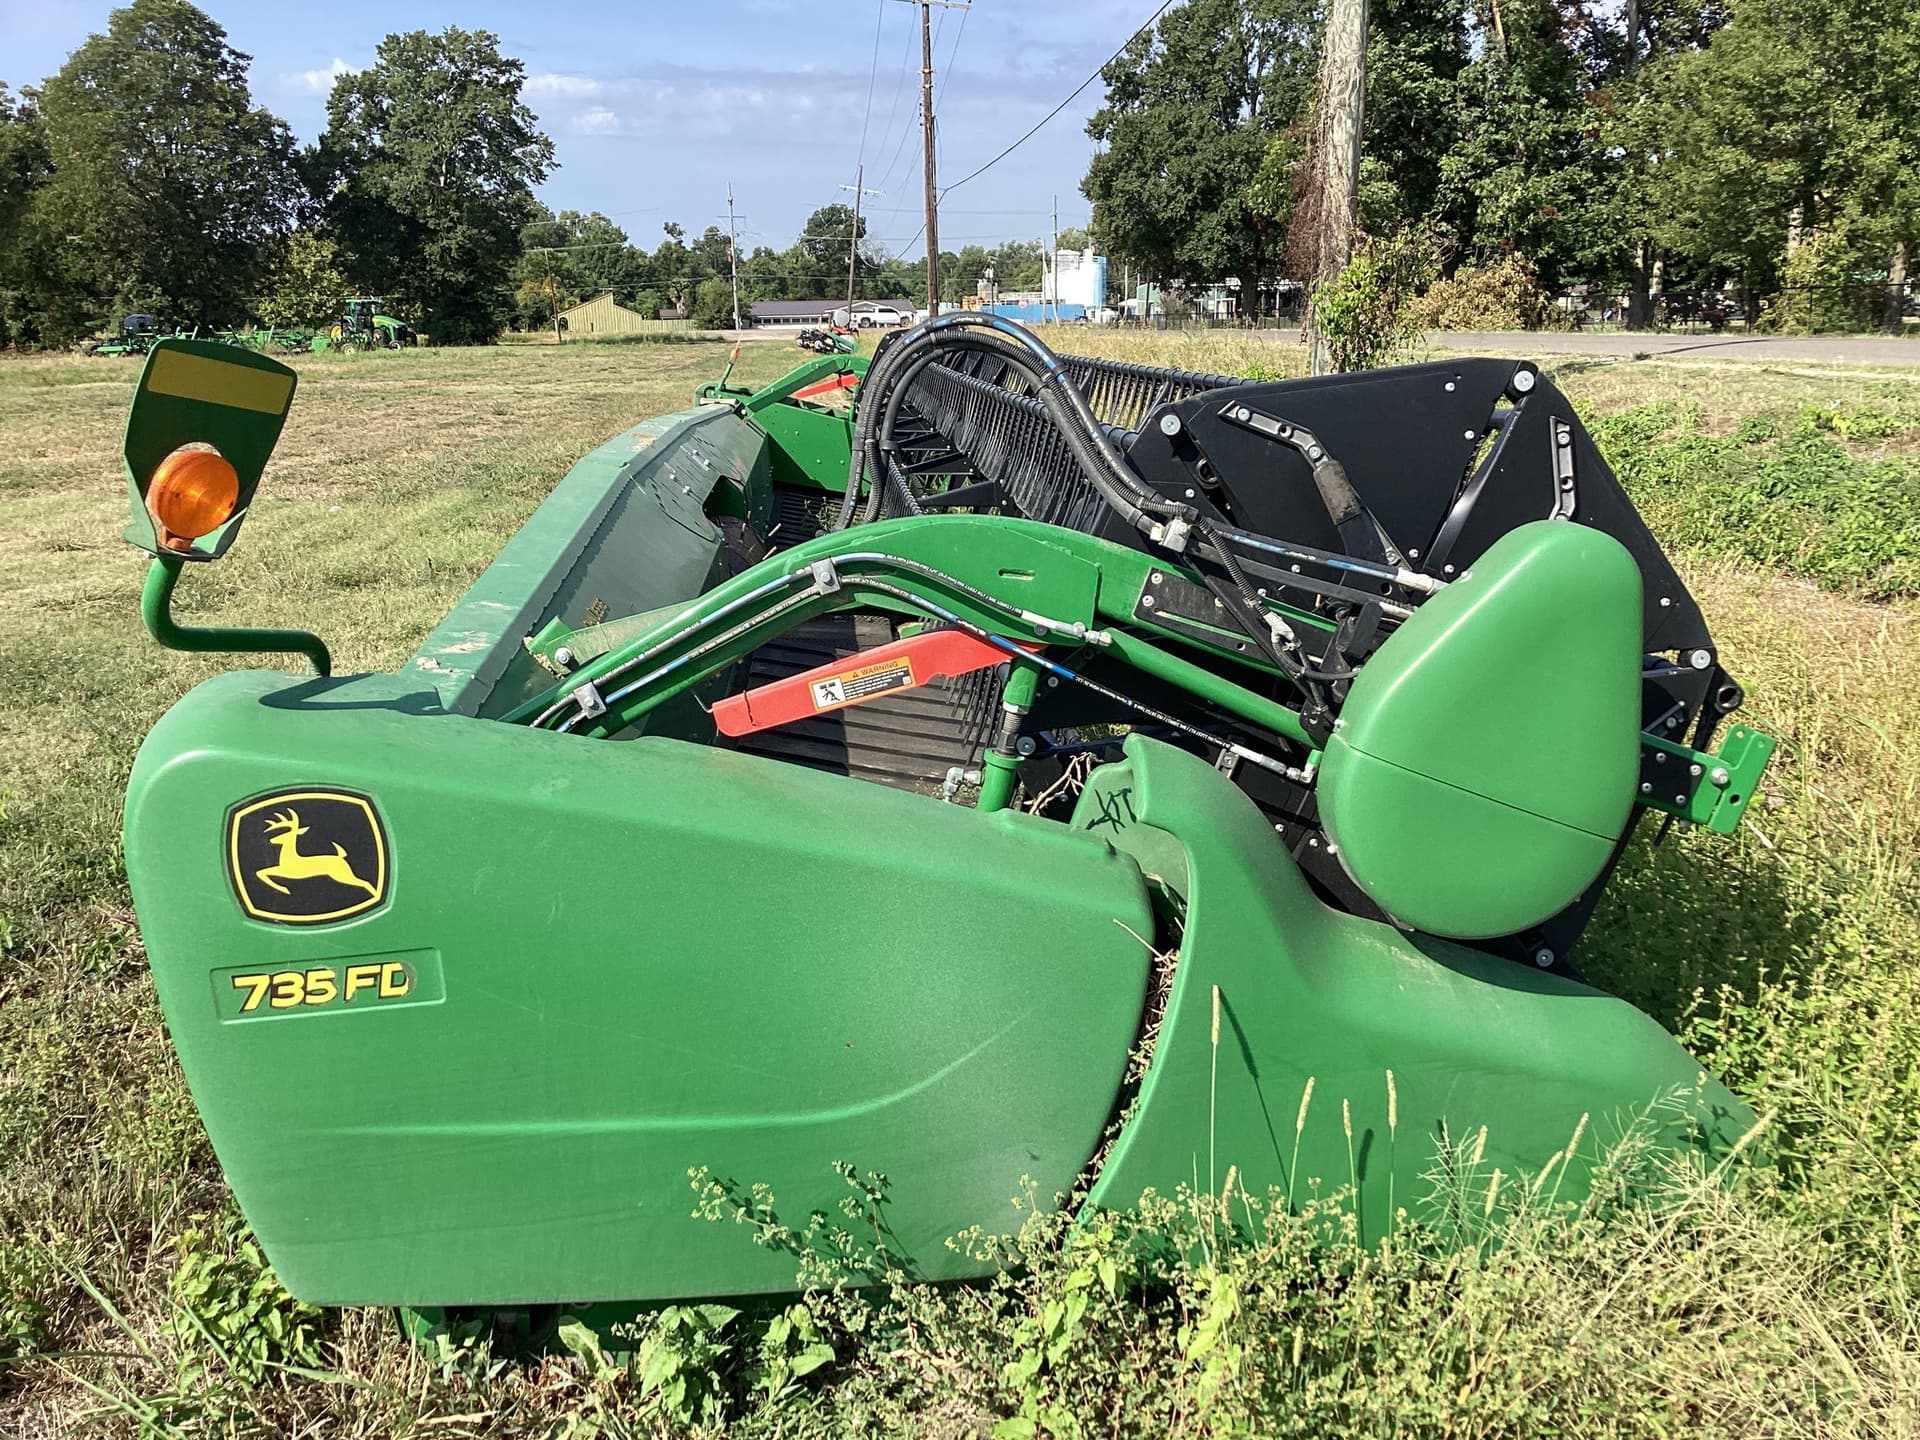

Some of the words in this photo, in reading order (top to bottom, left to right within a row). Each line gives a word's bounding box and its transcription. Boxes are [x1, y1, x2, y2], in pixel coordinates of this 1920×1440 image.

[860, 661, 898, 676] WARNING
[231, 967, 338, 1014] 735
[343, 961, 410, 1002] FD
